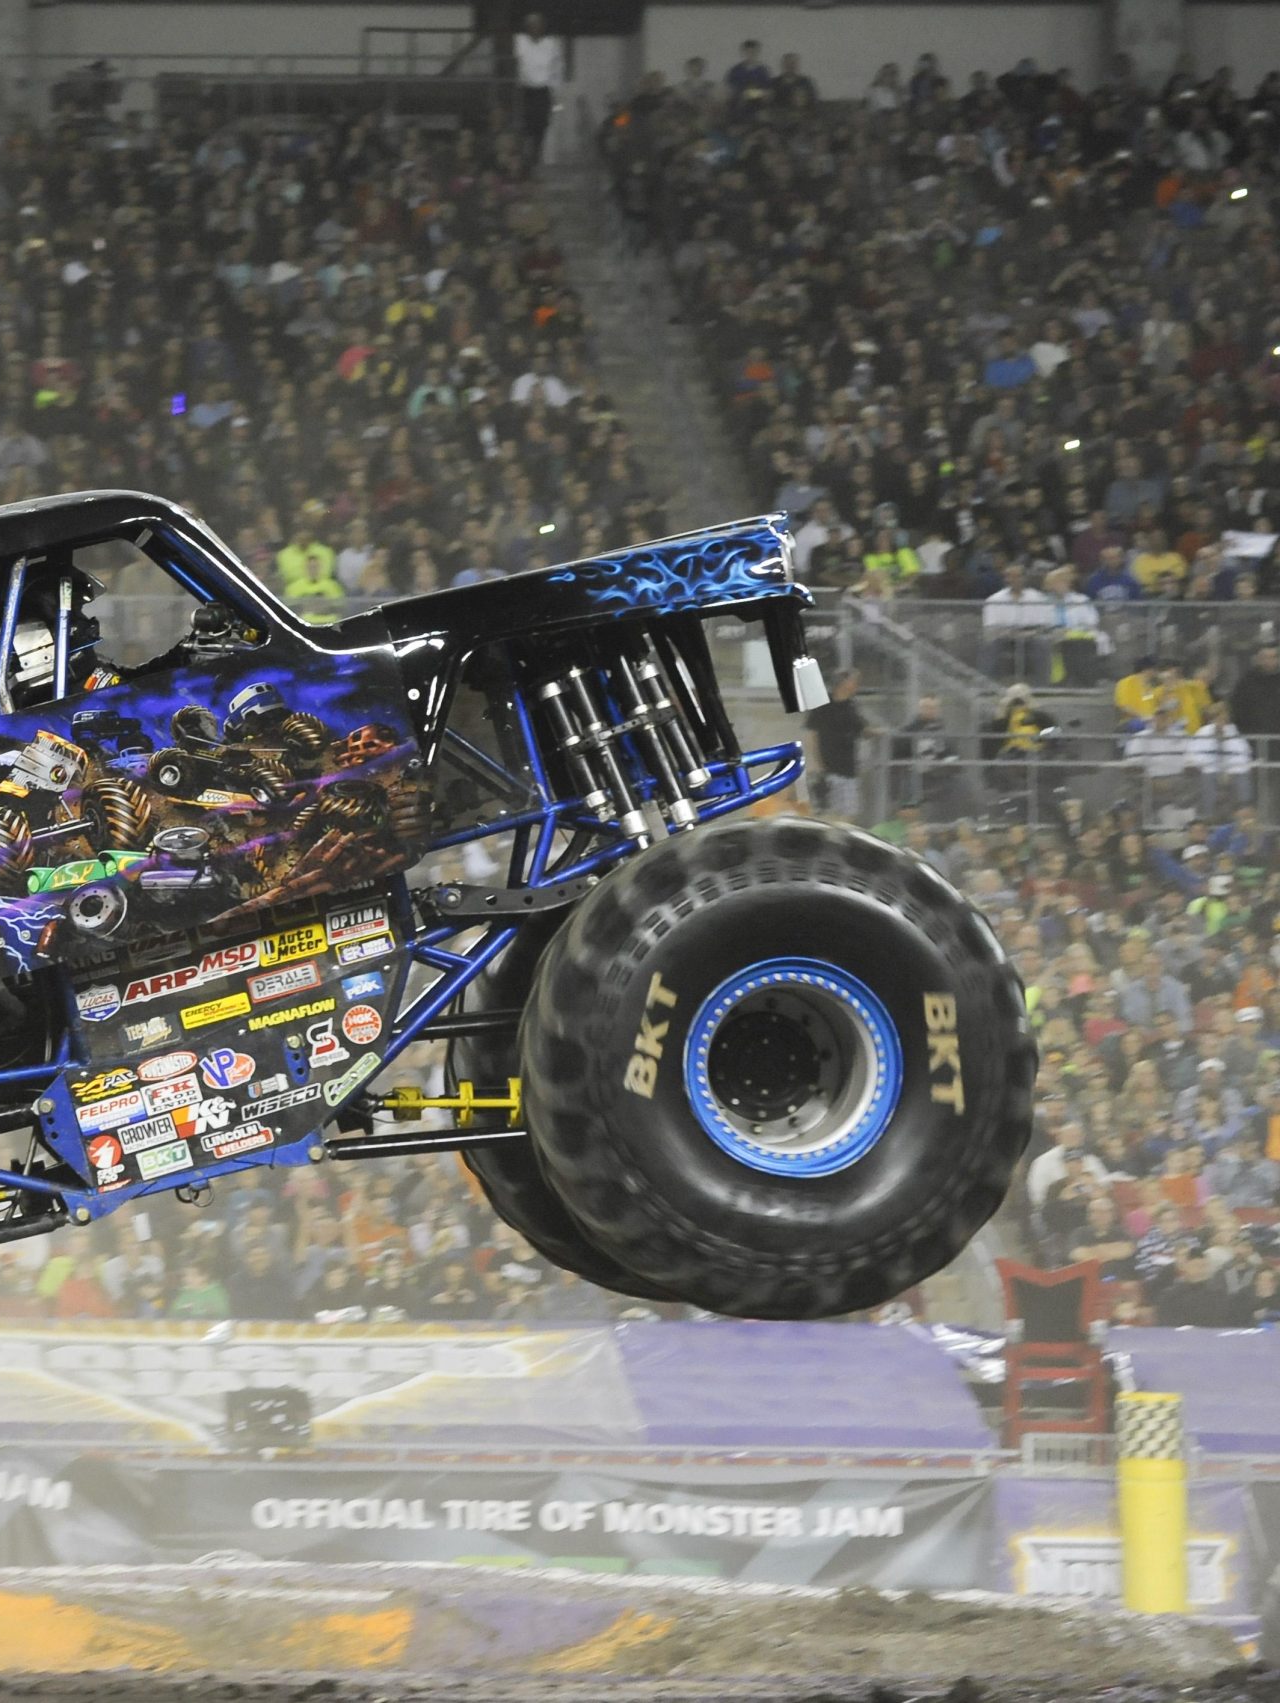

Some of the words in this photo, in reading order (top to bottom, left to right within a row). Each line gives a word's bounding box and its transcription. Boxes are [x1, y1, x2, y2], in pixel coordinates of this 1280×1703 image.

[331, 907, 384, 930] OPTIMA
[277, 937, 323, 958] Meter
[278, 928, 314, 946] Auto
[202, 943, 257, 972] MSD
[125, 968, 198, 1001] ARP
[254, 966, 313, 993] DERALE
[346, 979, 382, 1000] PEAK
[82, 992, 115, 1009] LUCAS
[248, 998, 336, 1031] MAGNAFLOW
[624, 971, 678, 1099] BKT
[924, 991, 965, 1116] BKT
[103, 1069, 138, 1090] PAC
[201, 1049, 235, 1088] VP
[79, 1094, 139, 1120] FEL-PRO
[153, 1095, 198, 1112] ENDS
[161, 1090, 196, 1104] ROD
[189, 1096, 237, 1135] K&N
[120, 1117, 173, 1146] CROWER
[205, 1123, 259, 1151] LINCOLN
[143, 1143, 188, 1171] BKT
[252, 1497, 434, 1531] OFFICIAL
[443, 1499, 532, 1532] TIRE
[540, 1501, 596, 1533] OF
[602, 1501, 804, 1537] MONSTER
[811, 1505, 905, 1538] JAM
